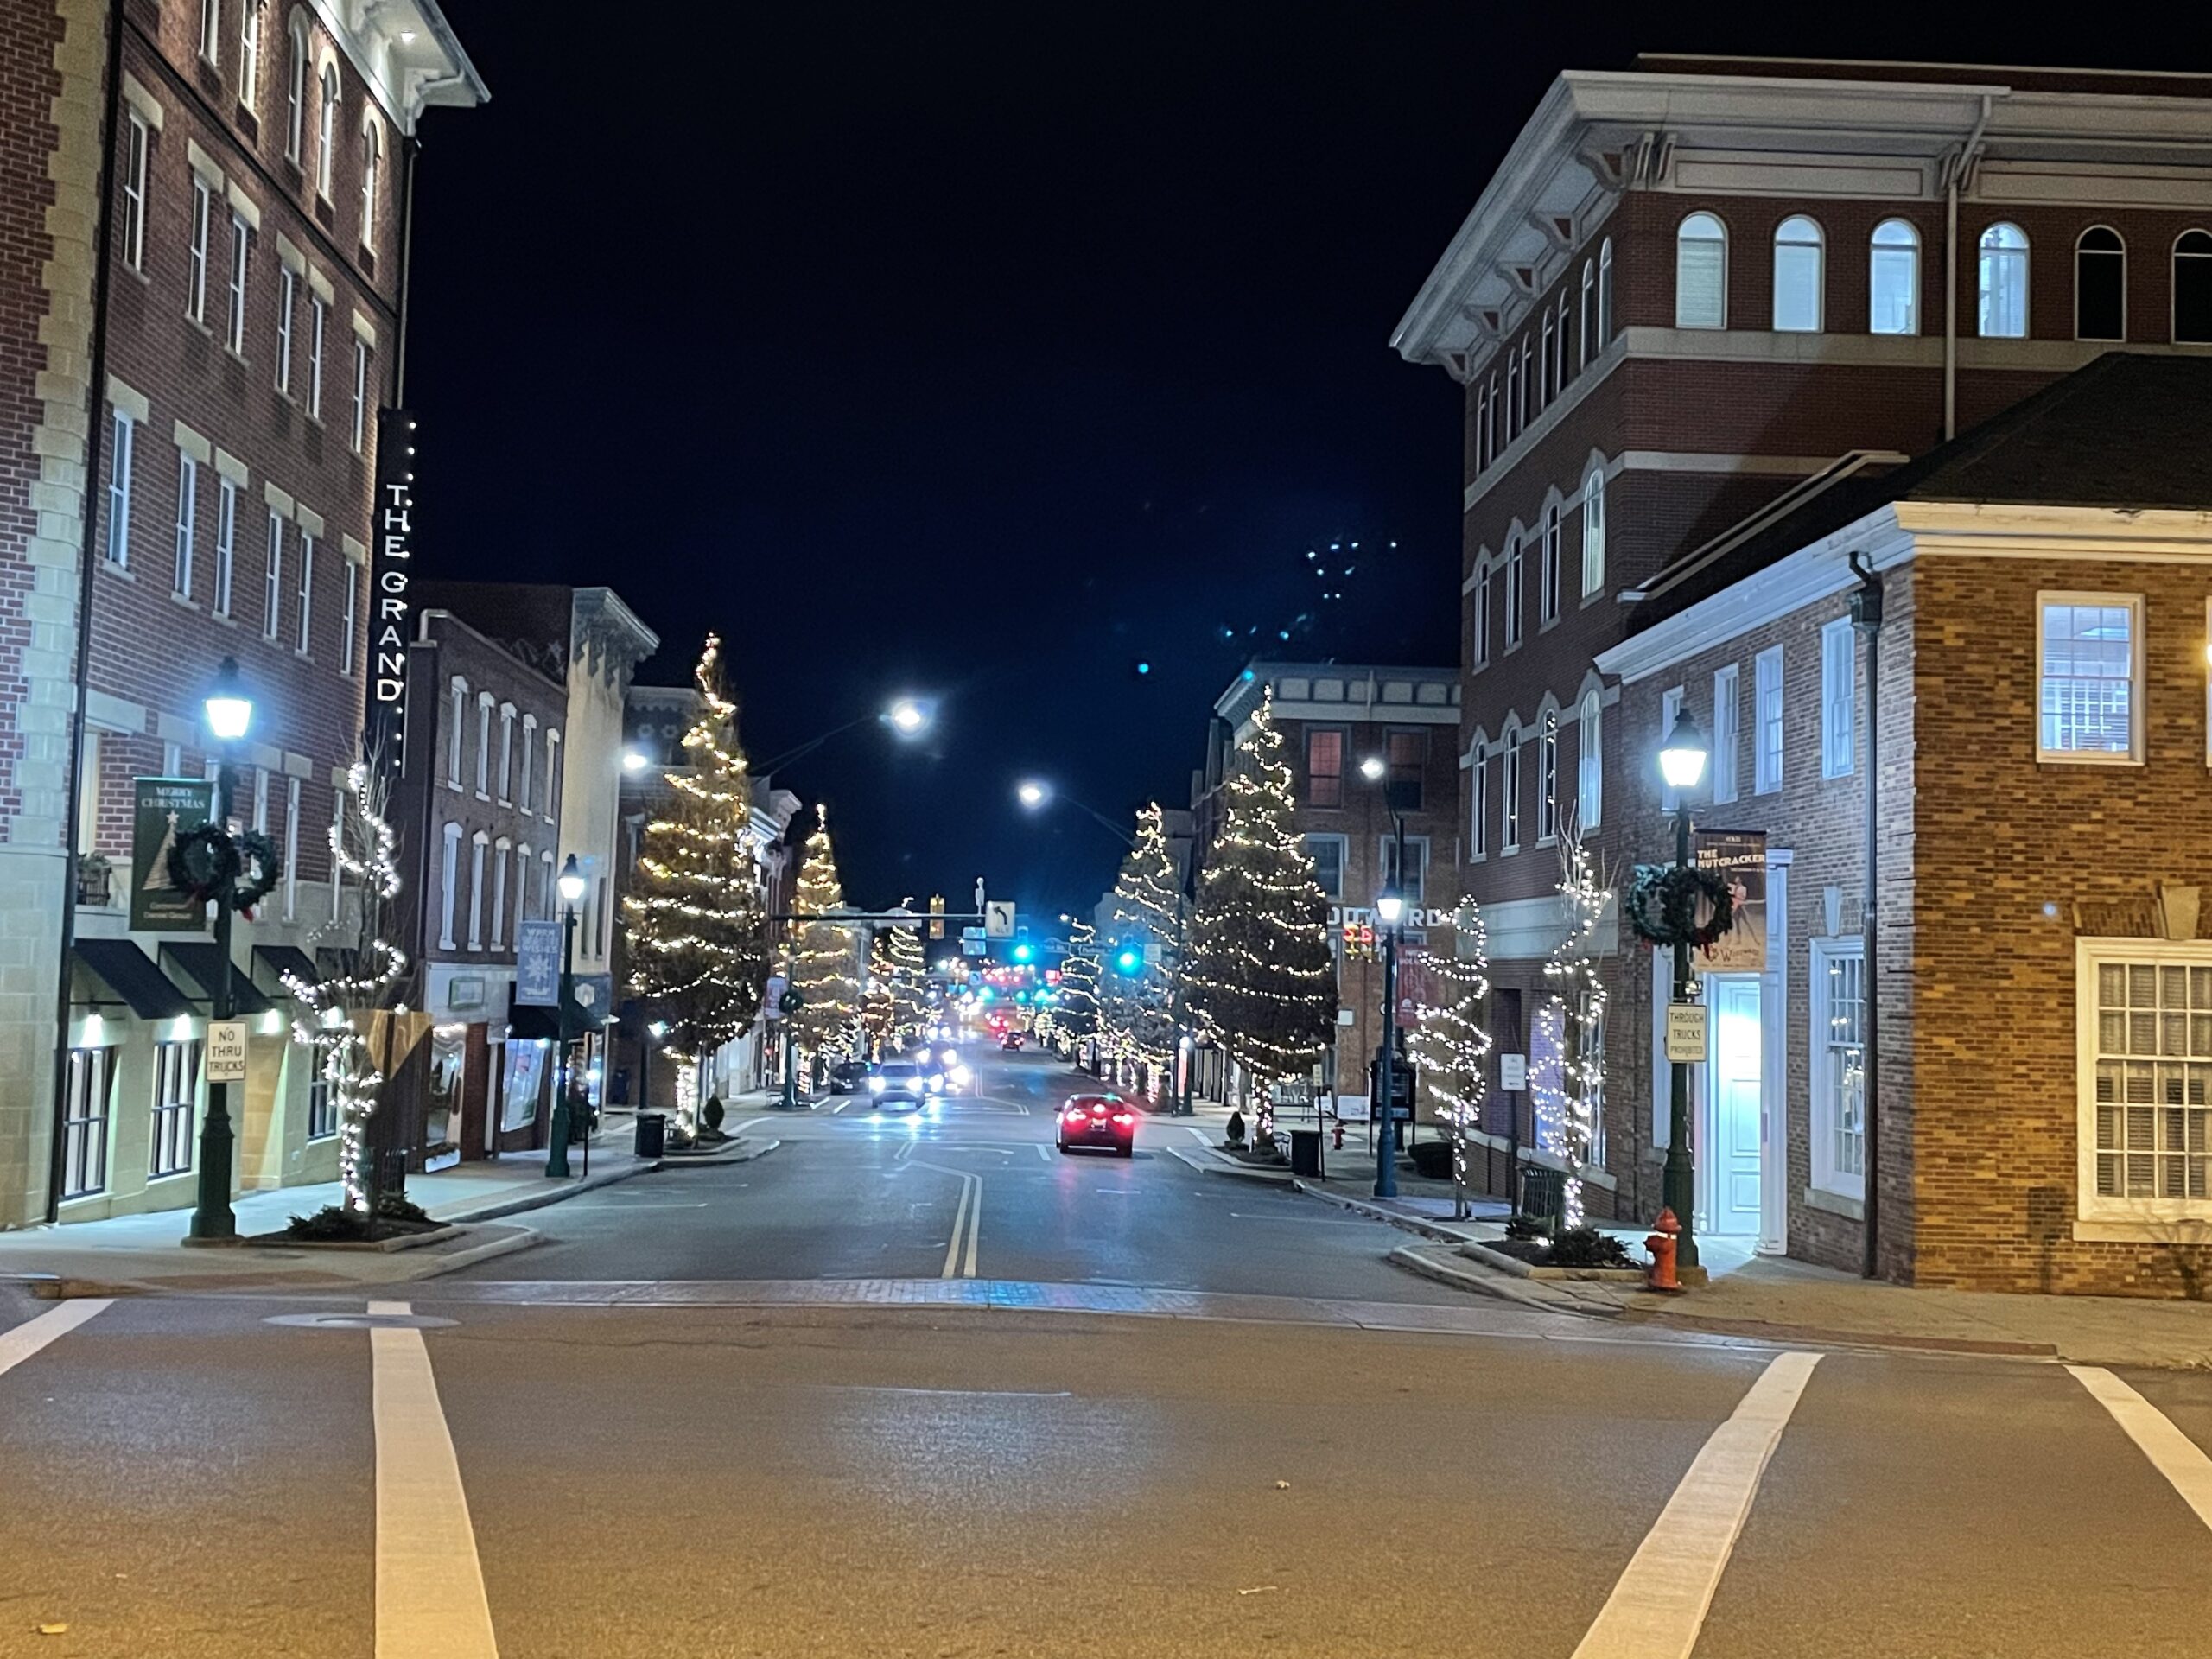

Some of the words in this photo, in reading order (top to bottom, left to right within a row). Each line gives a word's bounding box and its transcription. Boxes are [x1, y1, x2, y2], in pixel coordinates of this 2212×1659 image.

[385, 484, 410, 558] THE
[377, 571, 408, 702] GRAND
[156, 785, 194, 797] MERRY
[141, 798, 205, 809] CHRISTMAS
[1698, 849, 1718, 859] THE
[1698, 855, 1765, 868] NUTCRACKER
[1669, 1012, 1704, 1023] THROUGH
[219, 1030, 235, 1042] NO
[1673, 1029, 1701, 1040] TRUCKS
[212, 1046, 242, 1058] THRU
[209, 1060, 244, 1072] TRUCKS
